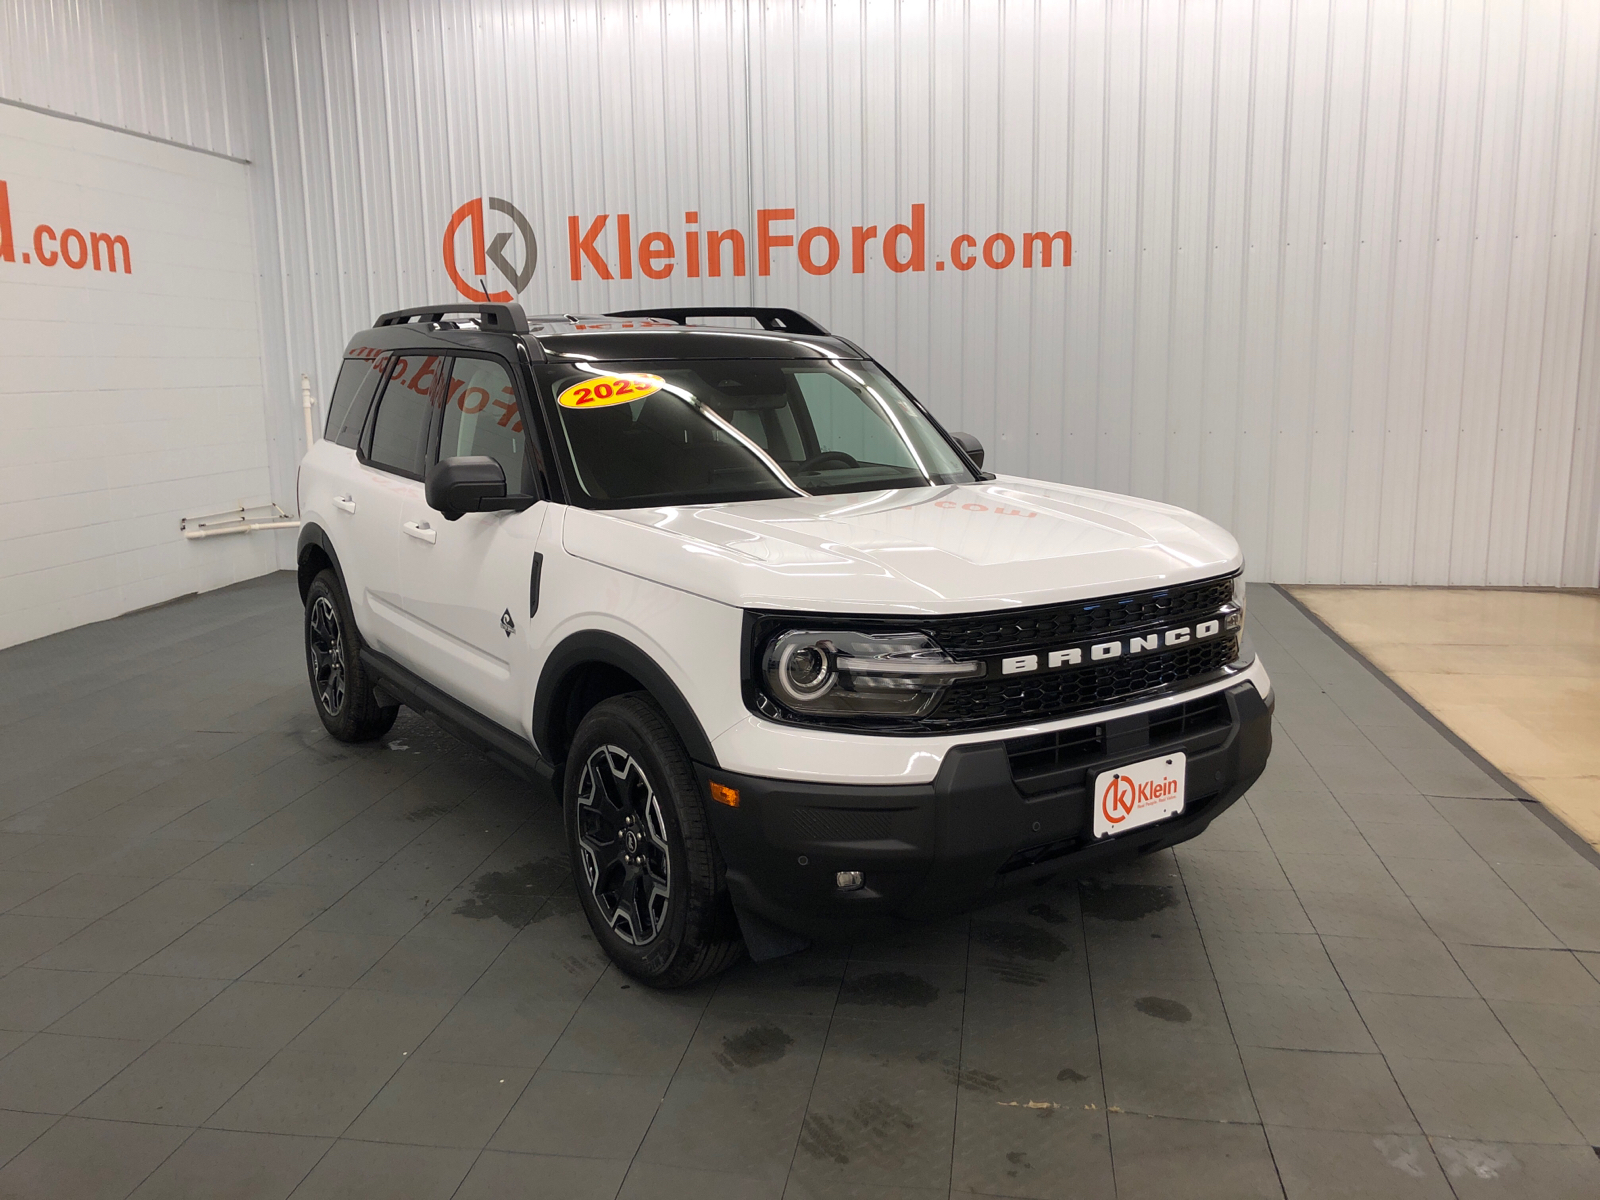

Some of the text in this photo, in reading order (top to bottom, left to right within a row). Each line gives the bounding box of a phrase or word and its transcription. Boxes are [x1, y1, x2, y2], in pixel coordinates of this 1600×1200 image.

[568, 203, 1072, 281] KleinFord.com
[1001, 619, 1220, 675] BRONCO
[1138, 776, 1178, 803] Klein
